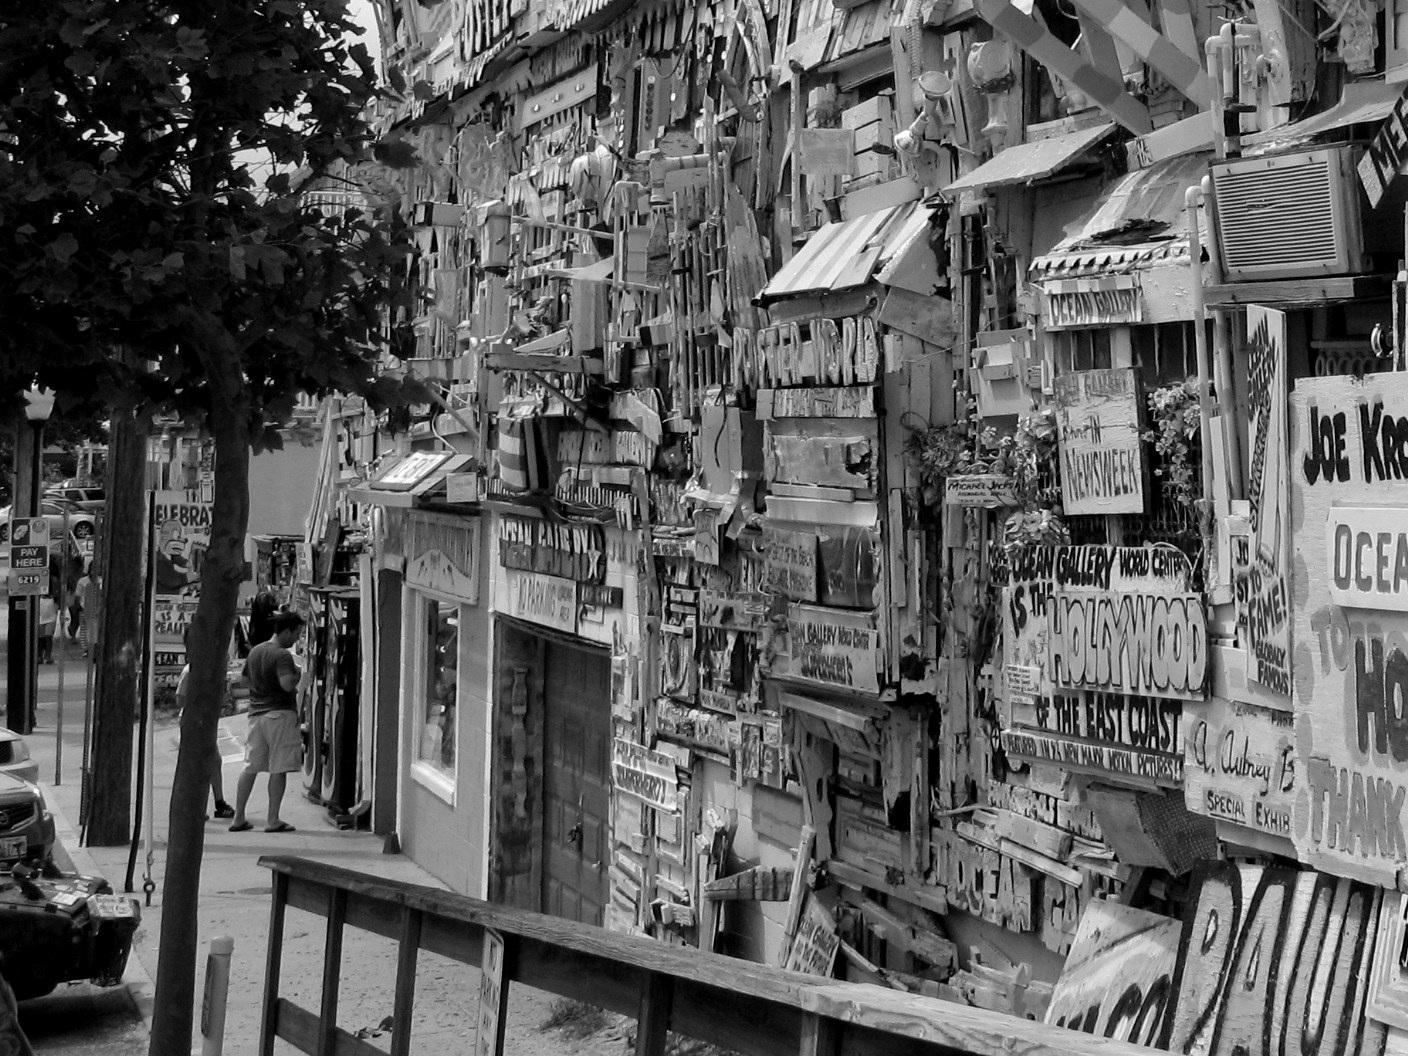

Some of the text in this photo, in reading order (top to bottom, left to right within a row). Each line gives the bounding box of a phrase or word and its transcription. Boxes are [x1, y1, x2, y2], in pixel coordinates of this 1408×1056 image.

[1305, 403, 1350, 485] JOE
[1065, 448, 1139, 502] NEWSWEEK
[15, 557, 44, 567] HERE
[20, 547, 39, 557] PAY
[1056, 546, 1119, 591] GALLERY
[1120, 547, 1150, 578] WORLD
[18, 575, 40, 585] 6219
[1010, 585, 1028, 639] IS
[1249, 576, 1281, 650] FAME!
[1047, 594, 1208, 692] HOLLYWOOD
[1310, 604, 1351, 676] TO
[1054, 694, 1081, 738] THE
[1086, 694, 1126, 744] EAST
[1128, 695, 1184, 756] COAST
[1206, 790, 1246, 818] SPECIAL
[1306, 756, 1406, 862] THANK
